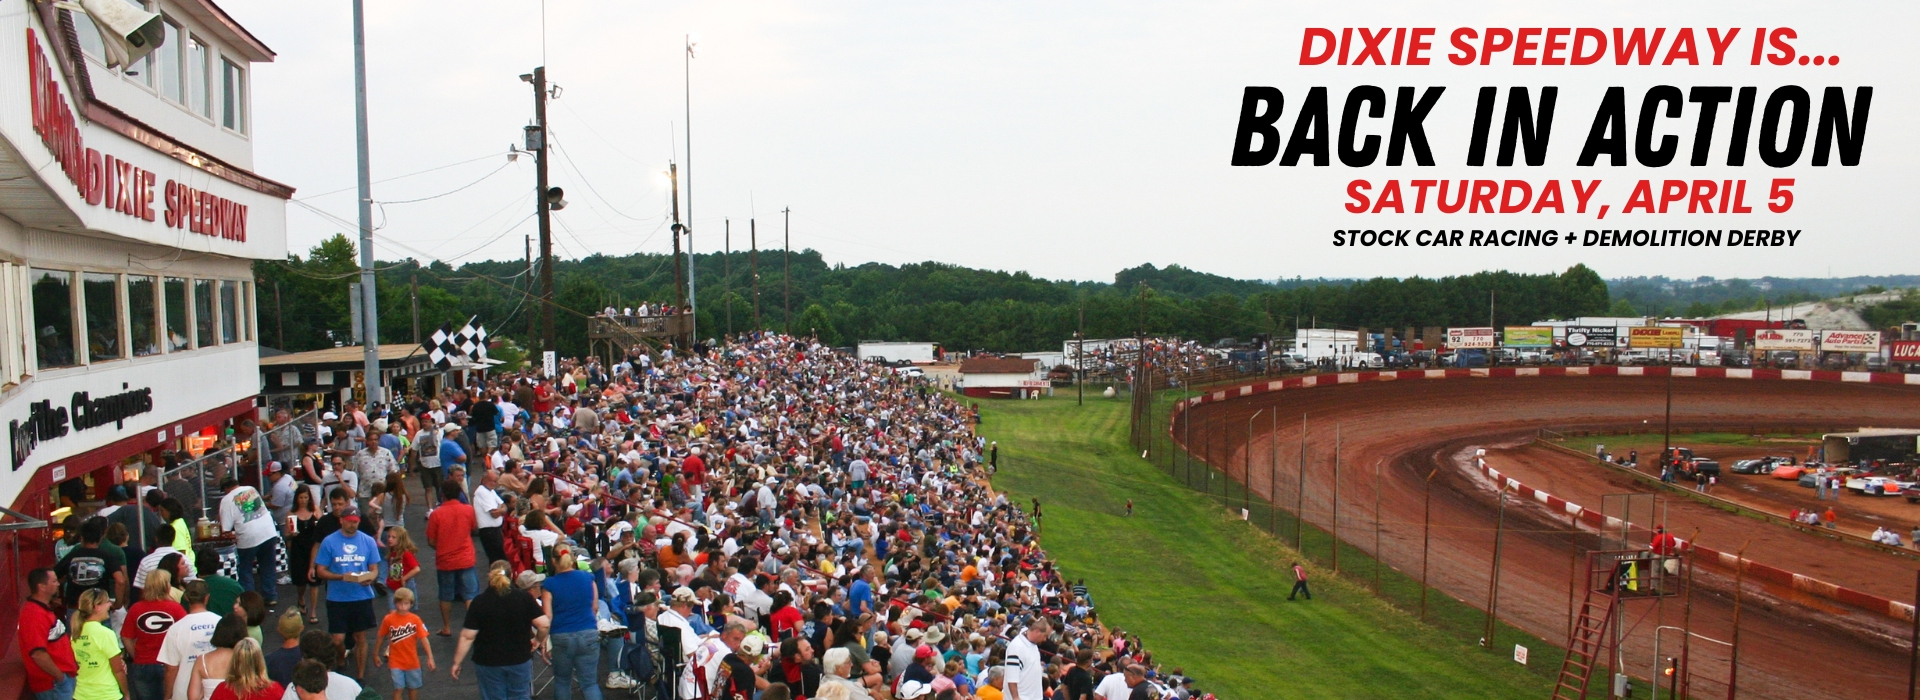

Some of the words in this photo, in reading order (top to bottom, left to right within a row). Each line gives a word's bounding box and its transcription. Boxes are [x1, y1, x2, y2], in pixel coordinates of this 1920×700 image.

[86, 147, 156, 222] DIXIE
[164, 179, 248, 243] SPEEDWAY
[71, 382, 153, 431] Champions
